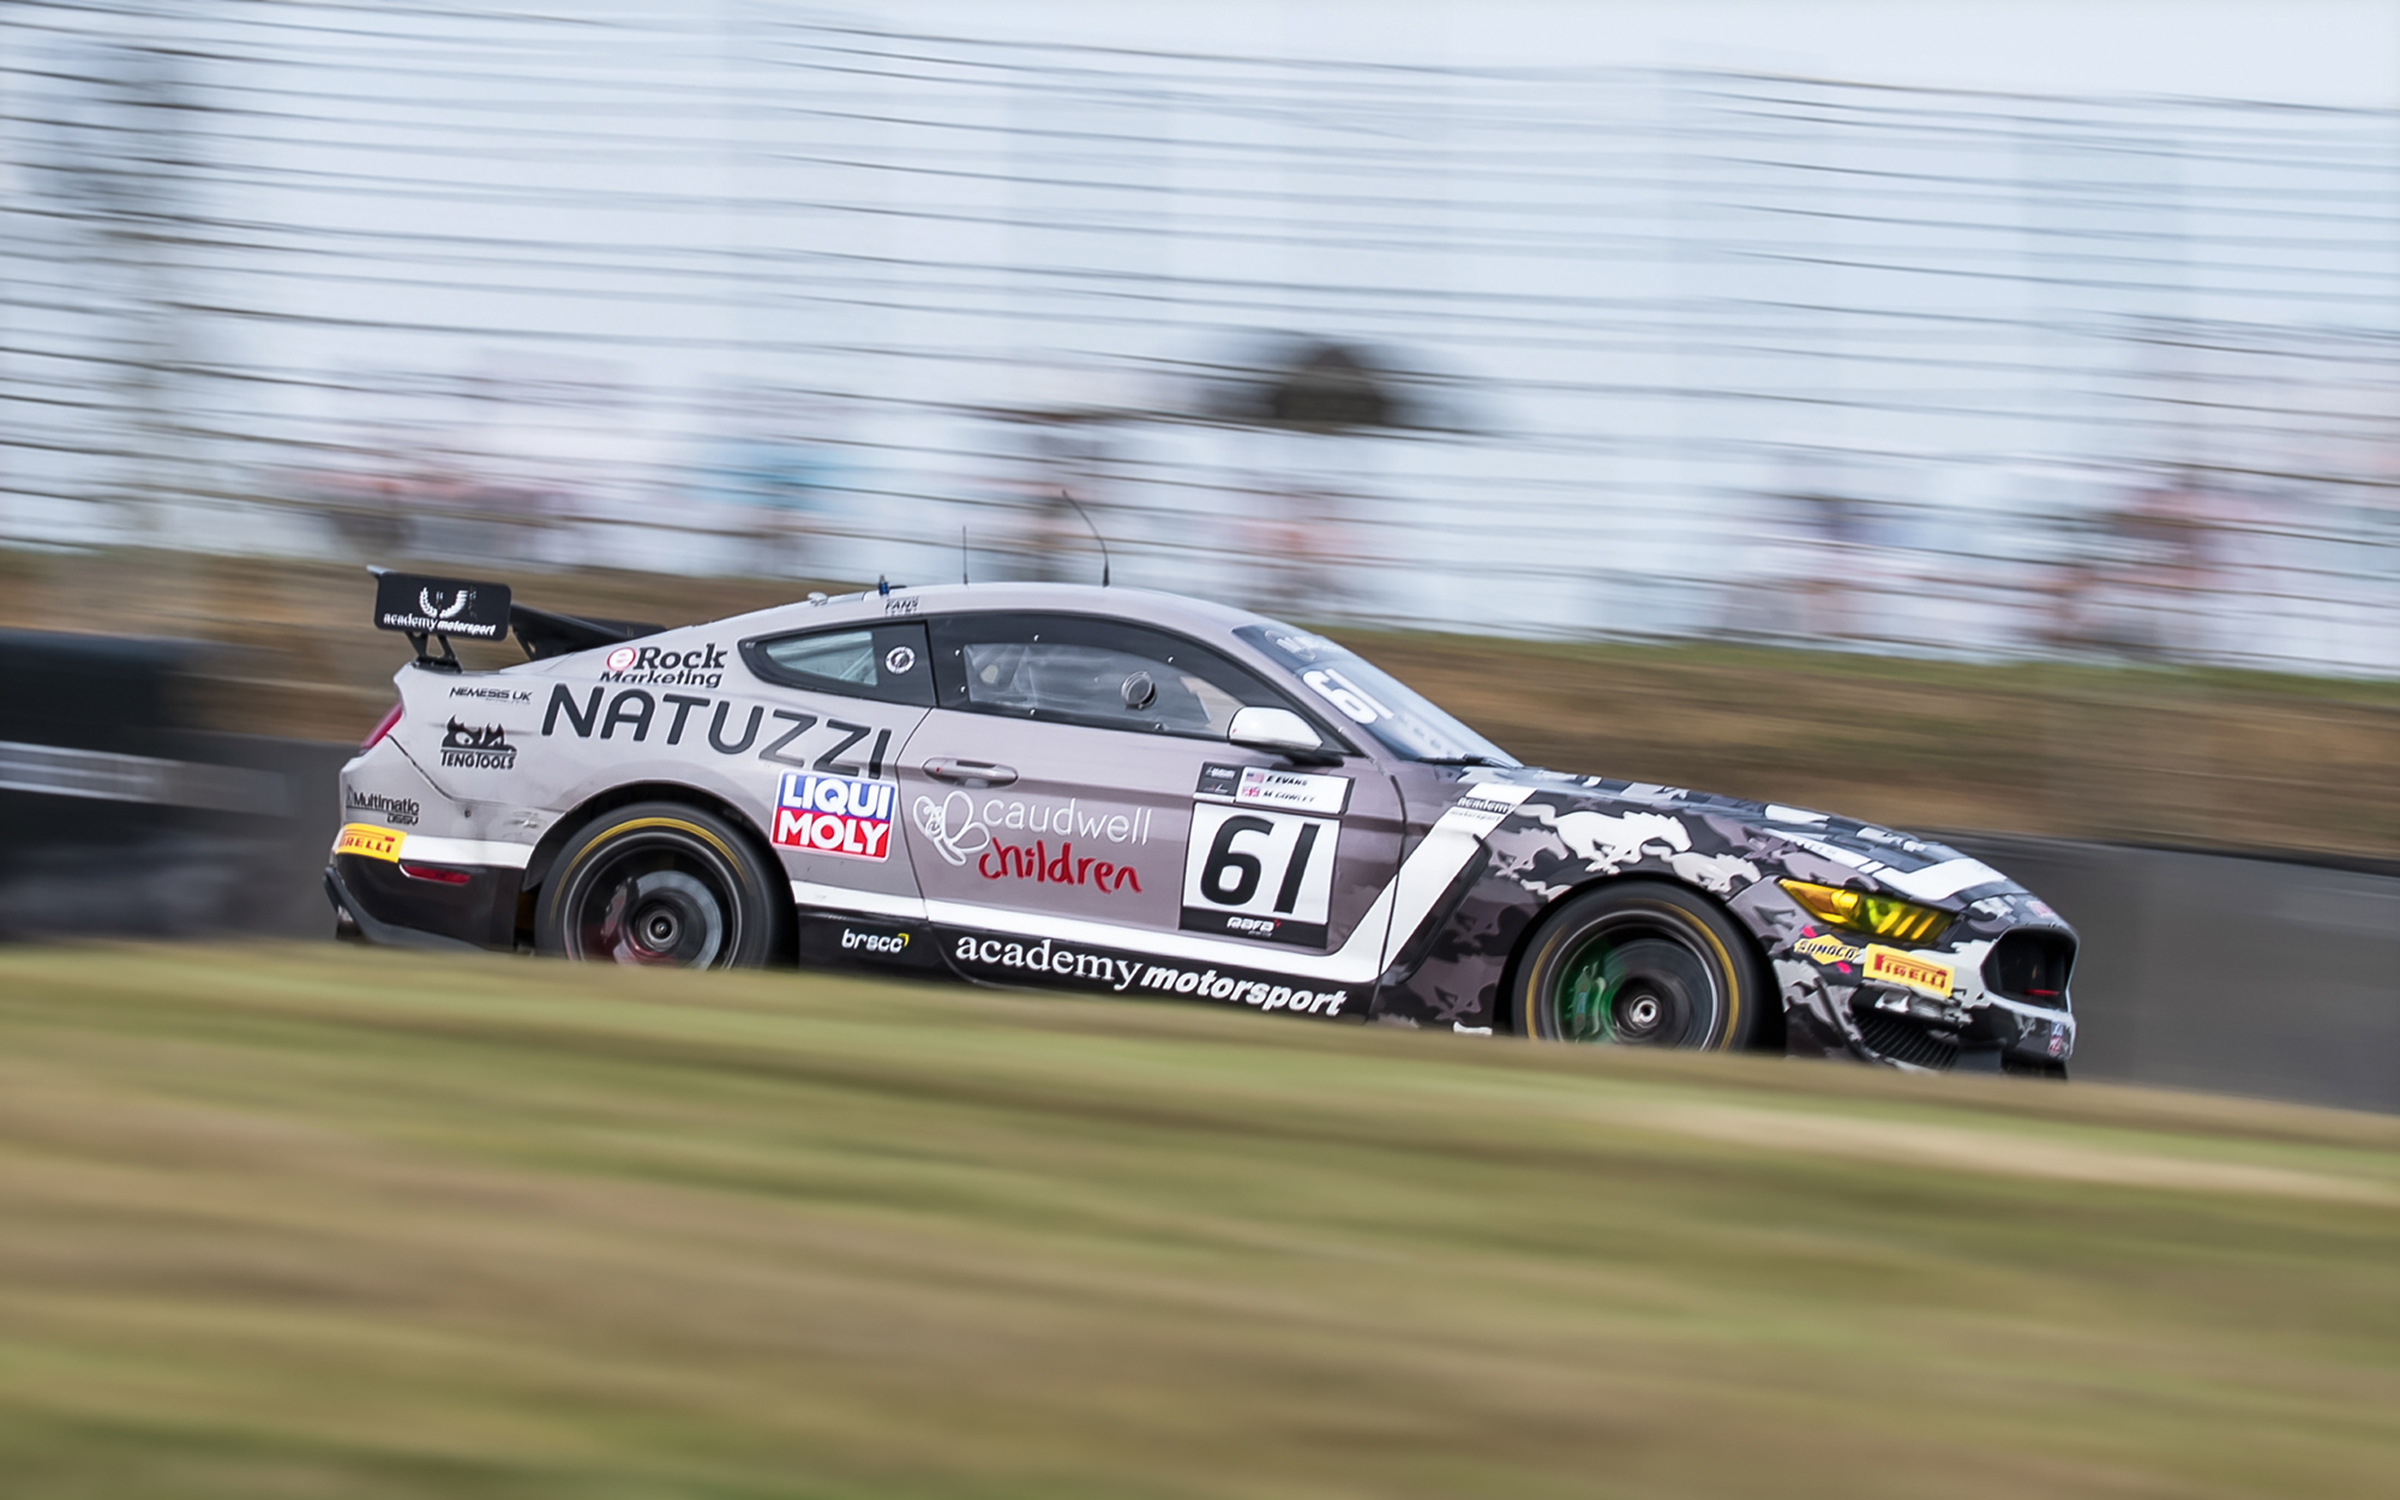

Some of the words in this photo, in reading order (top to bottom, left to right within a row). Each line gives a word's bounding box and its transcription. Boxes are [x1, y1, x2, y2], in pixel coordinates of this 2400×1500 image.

[600, 669, 724, 689] Marketing
[633, 642, 729, 670] Rock
[449, 686, 512, 700] NEMESIS
[511, 690, 534, 702] UK
[1302, 667, 1396, 725] 61
[541, 682, 893, 780] NATUZZI
[782, 774, 892, 821] LIQUI
[777, 817, 890, 861] MOLY
[982, 798, 1152, 846] caudwell
[1200, 814, 1322, 915] 61
[955, 936, 1142, 992] academy
[1140, 966, 1349, 1017] motorsport
[1873, 953, 1948, 990] PIRELLI
